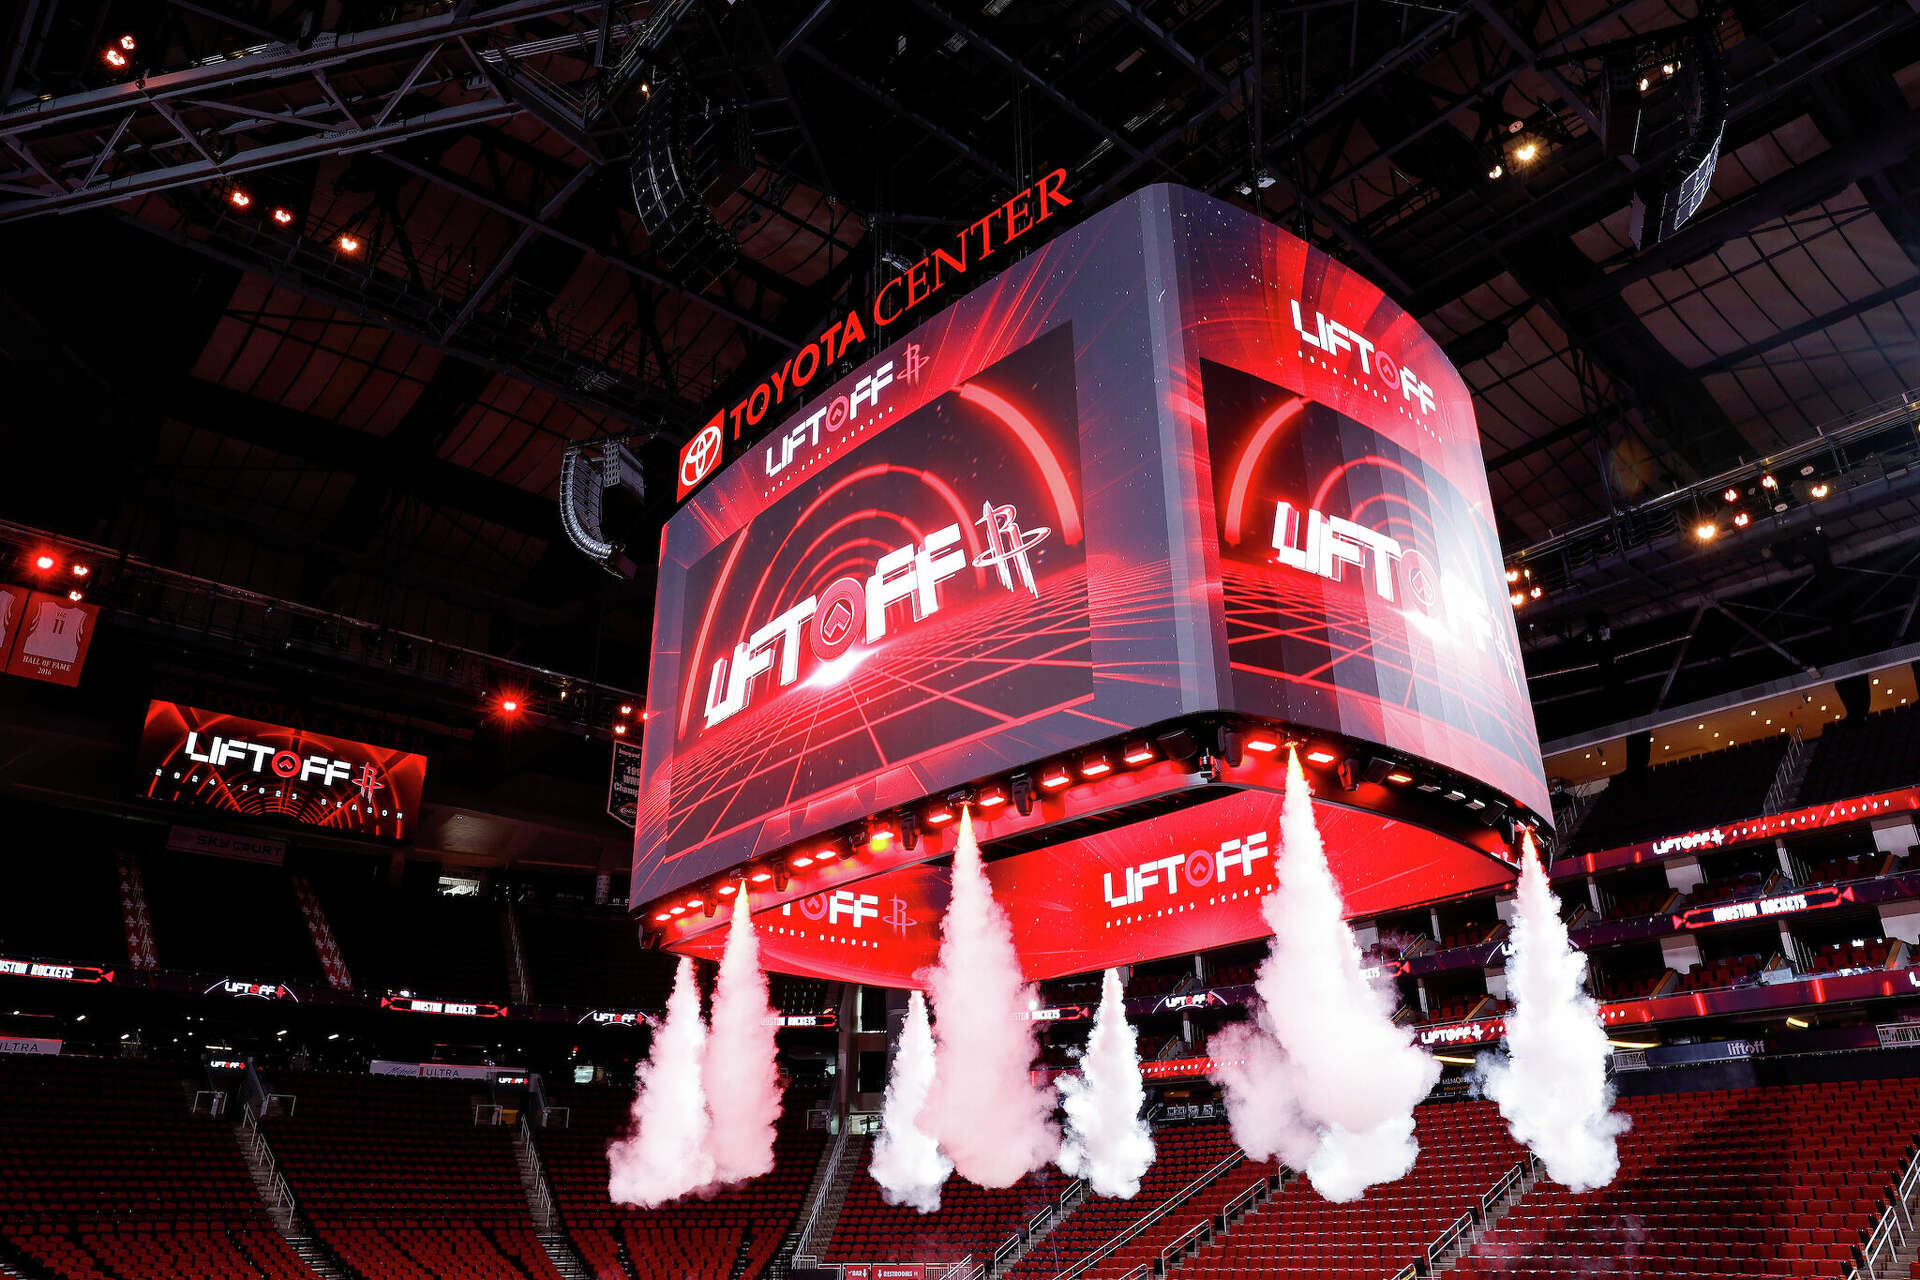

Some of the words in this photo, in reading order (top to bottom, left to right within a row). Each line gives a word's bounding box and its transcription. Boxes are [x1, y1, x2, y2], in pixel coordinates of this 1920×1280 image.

[730, 310, 866, 440] TOYOTA
[873, 167, 1073, 326] CENTER
[1291, 298, 1436, 415] LIFTOFF
[766, 360, 893, 478] LIFTOFF
[52, 618, 65, 635] 11
[704, 523, 966, 728] LIFTOFF
[22, 655, 41, 666] HALL
[41, 659, 50, 668] OF
[52, 660, 71, 672] FAME
[185, 731, 351, 786] LIFTOFF
[320, 798, 403, 820] SEASON
[1103, 831, 1269, 909] LIFTOFF
[0, 960, 28, 974] USTON
[31, 964, 74, 979] ROCKETS
[224, 981, 276, 995] LIFTOFF
[593, 1012, 636, 1023] LIFTOFF
[425, 1067, 459, 1077] ULTRA
